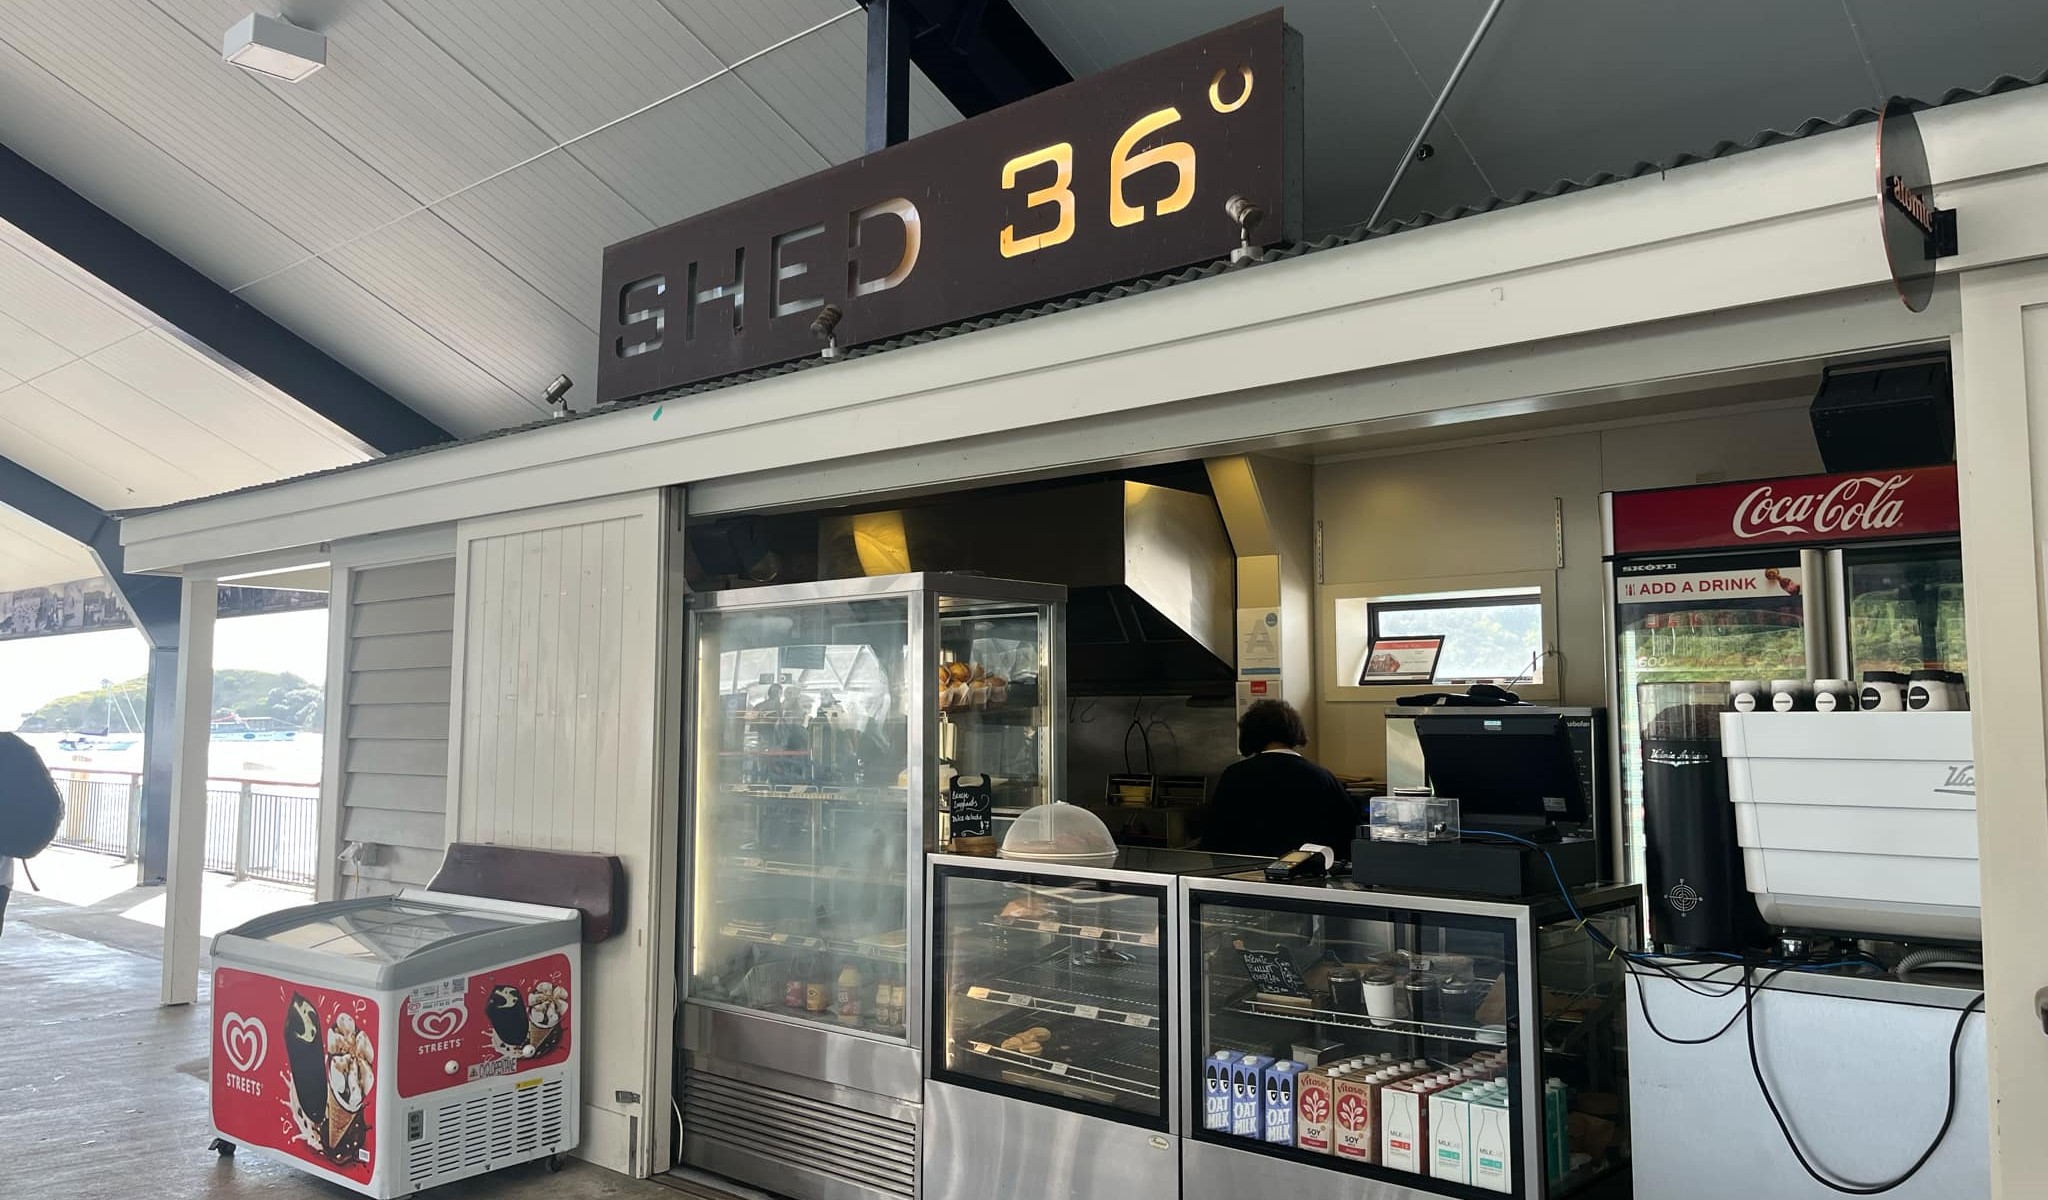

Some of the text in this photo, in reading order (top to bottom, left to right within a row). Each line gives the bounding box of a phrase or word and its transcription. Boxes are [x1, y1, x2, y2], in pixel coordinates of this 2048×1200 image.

[1893, 176, 1933, 232] atomic
[615, 197, 922, 358] SHED
[1732, 474, 1914, 538] Coca-Cola
[1622, 563, 1677, 572] SKOPE
[1639, 577, 1757, 595] ADD A DRINK
[418, 1039, 461, 1055] STREETS
[226, 1072, 261, 1097] STREETS
[1207, 1096, 1229, 1113] OAT
[1234, 1101, 1257, 1119] OAT
[1207, 1112, 1229, 1129] MILK
[1233, 1117, 1257, 1135] MILK
[1267, 1108, 1290, 1126] OAT
[1266, 1124, 1290, 1142] MILK
[1307, 1127, 1321, 1136] SOY
[1345, 1135, 1359, 1144] SOY
